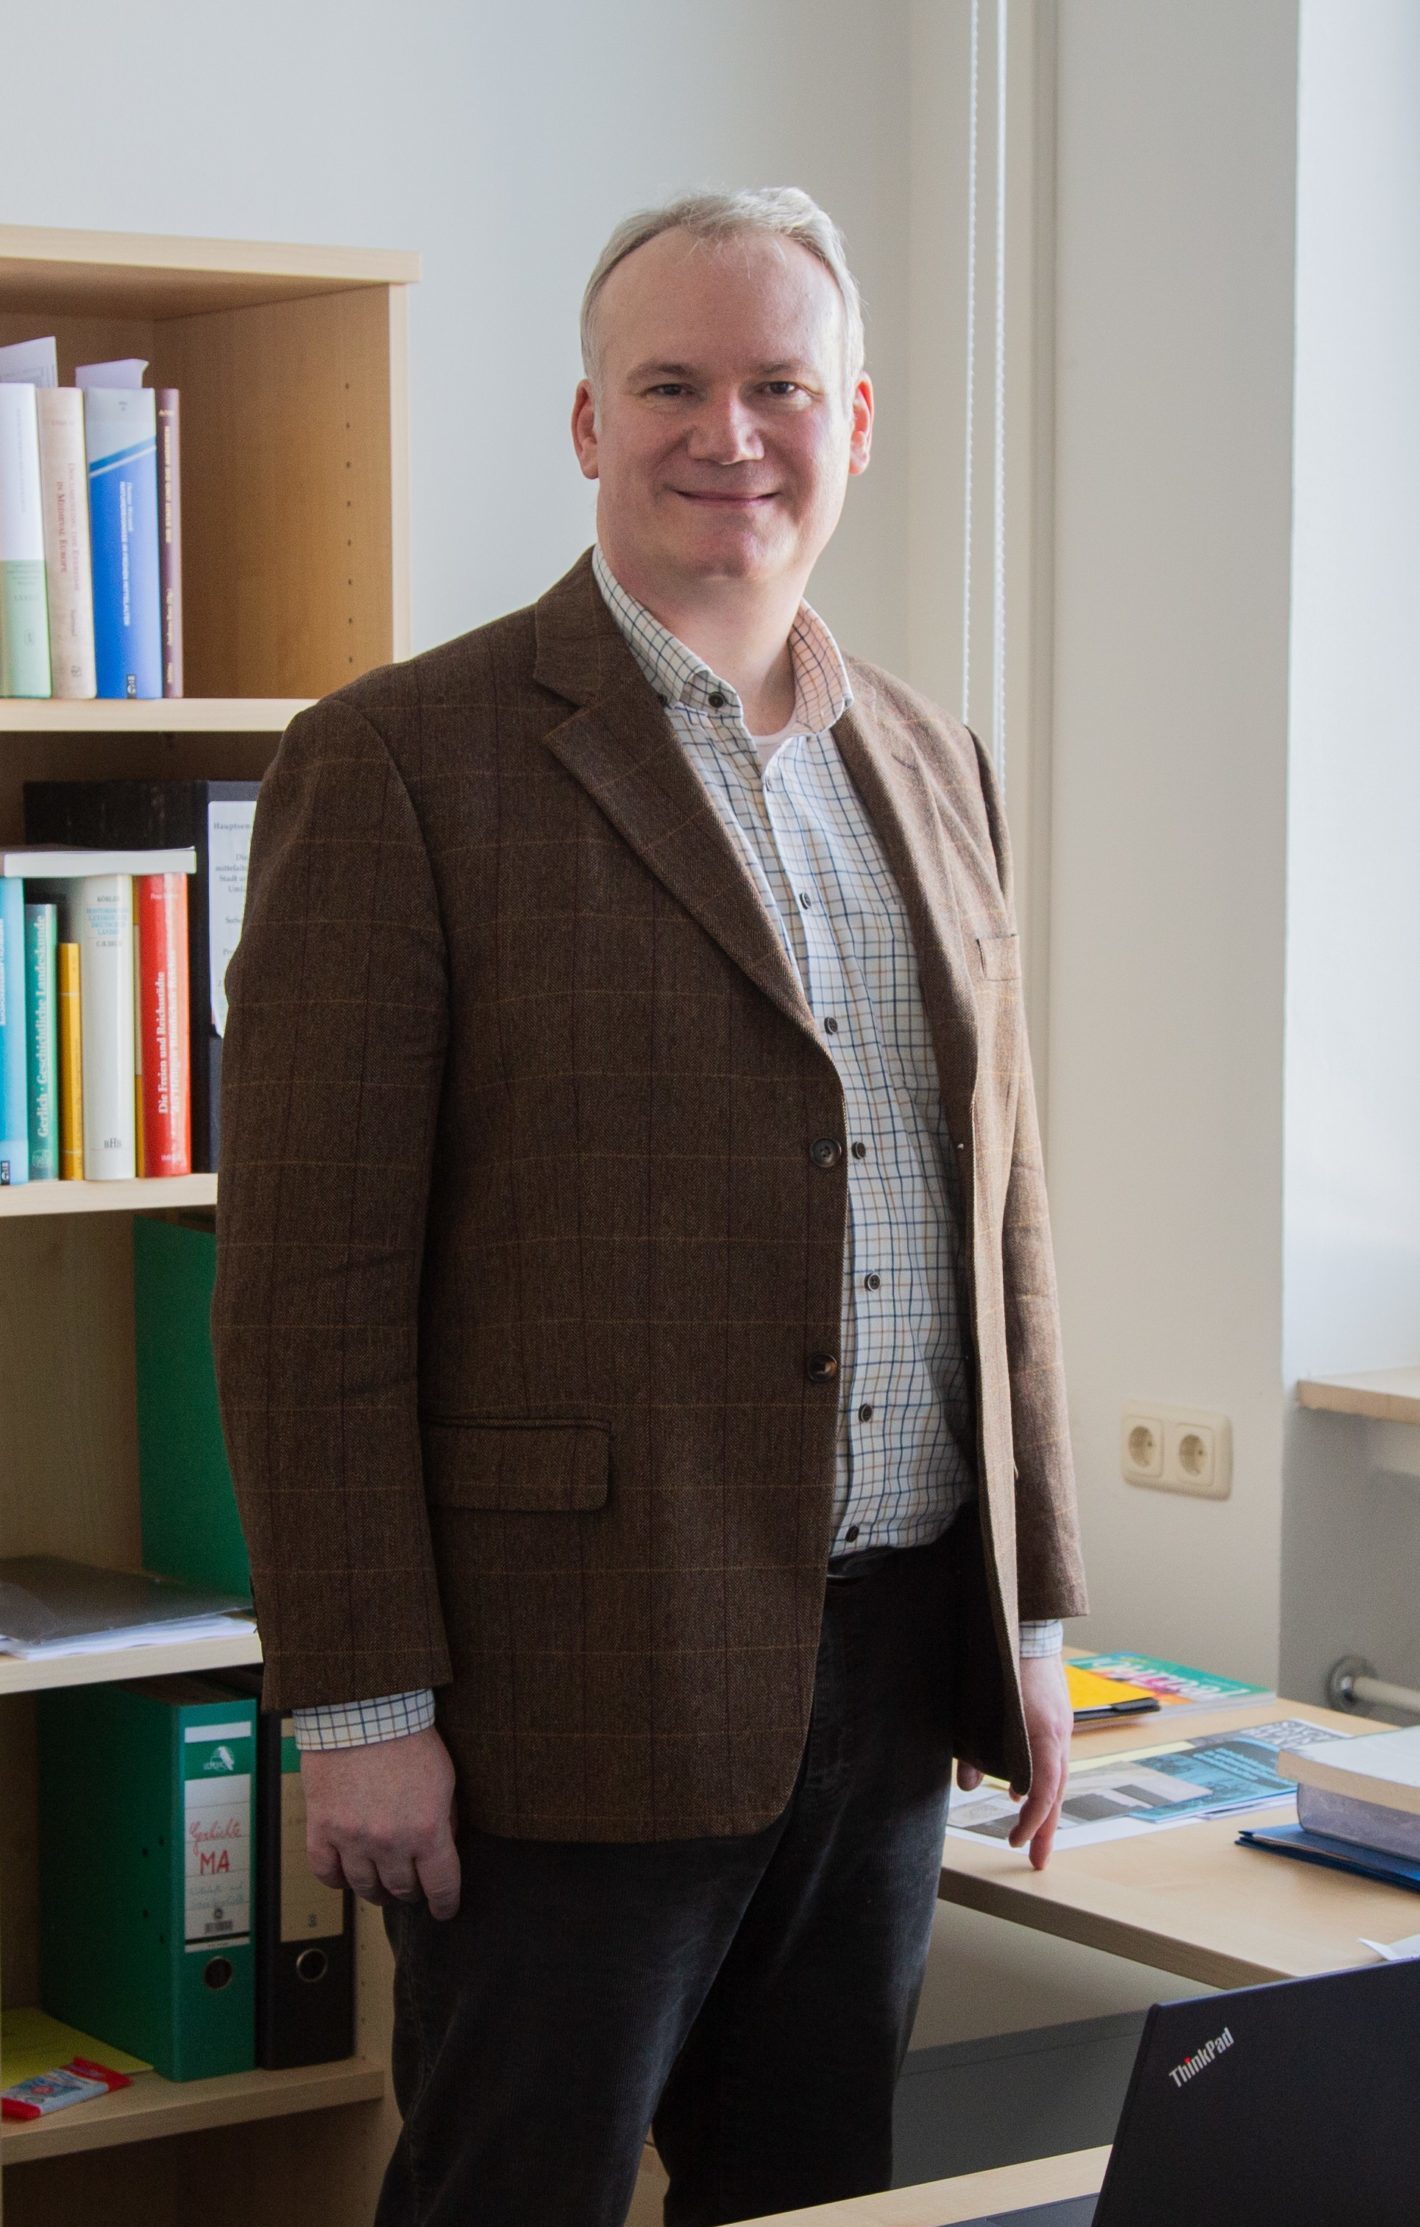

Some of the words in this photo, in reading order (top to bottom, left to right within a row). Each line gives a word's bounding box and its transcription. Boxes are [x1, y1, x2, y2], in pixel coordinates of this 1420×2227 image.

[34, 915, 47, 996] Landeskunde
[155, 971, 166, 1035] Reichsstädte
[35, 999, 48, 1084] Geschichtliche
[156, 1037, 166, 1058] und
[157, 1059, 167, 1092] Freien
[36, 1094, 48, 1137] Gerlich
[158, 1093, 168, 1114] Die
[200, 1849, 230, 1876] MA
[1168, 2026, 1234, 2088] ThinkPad
